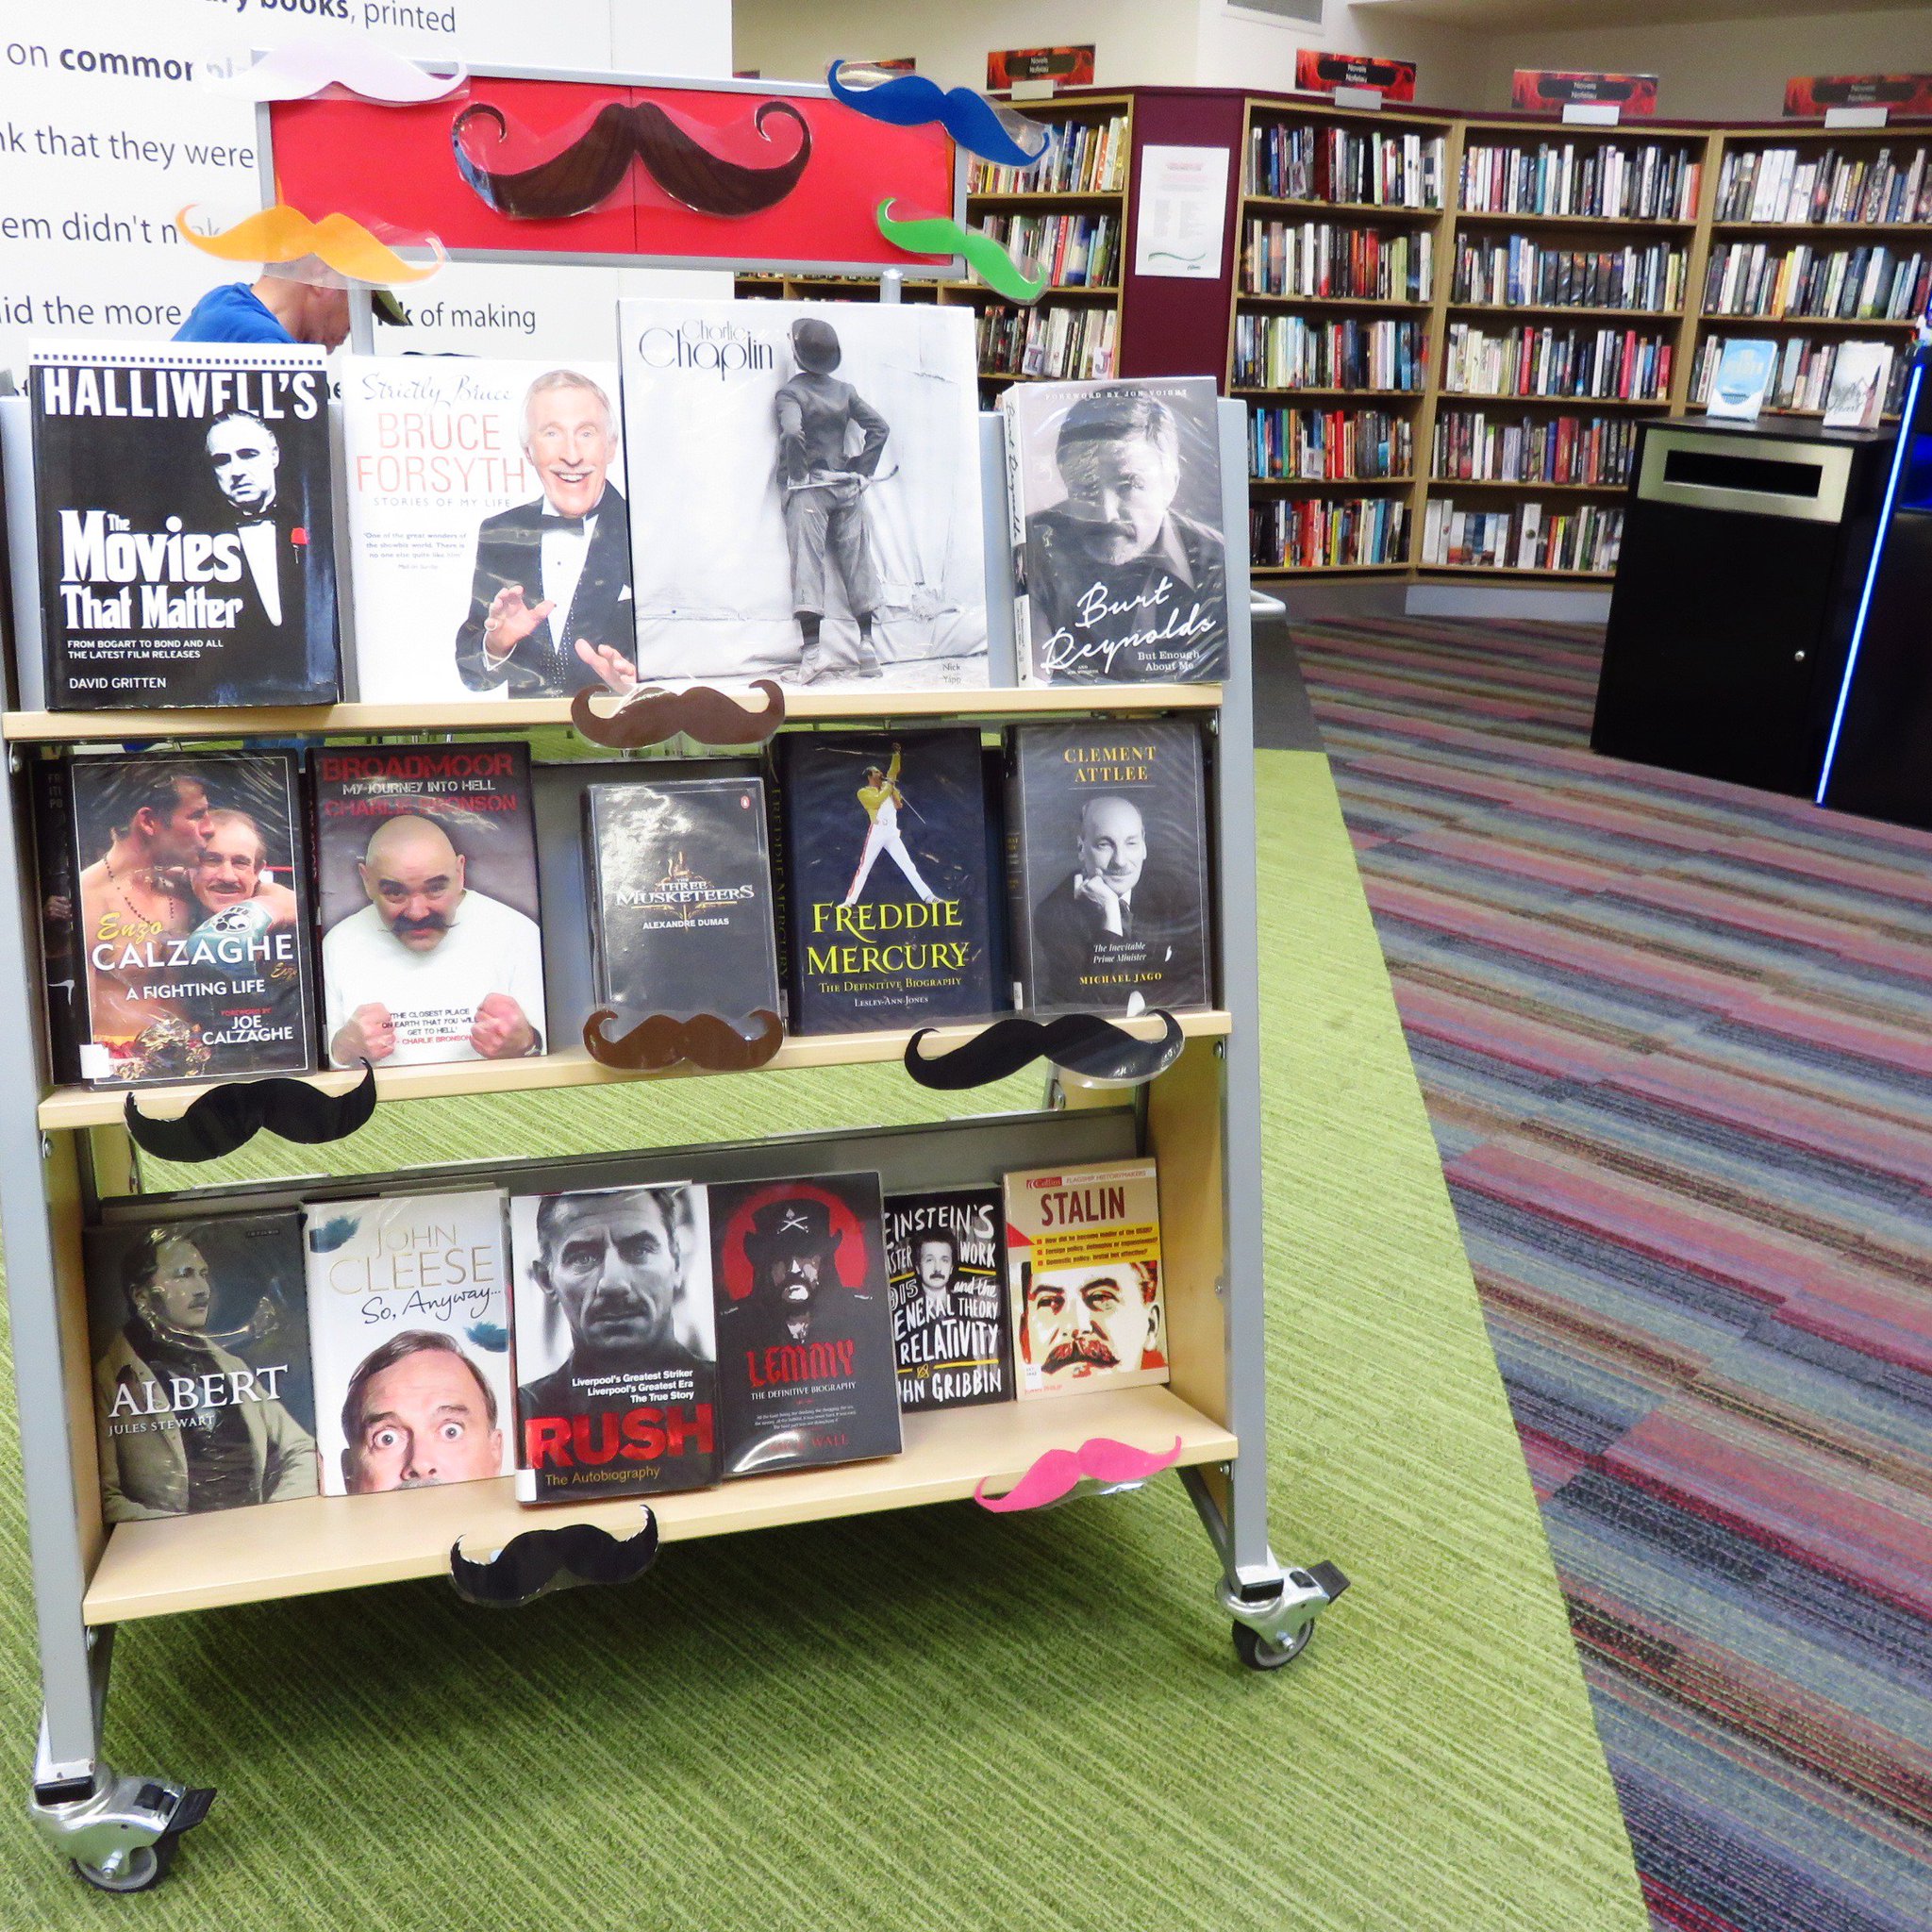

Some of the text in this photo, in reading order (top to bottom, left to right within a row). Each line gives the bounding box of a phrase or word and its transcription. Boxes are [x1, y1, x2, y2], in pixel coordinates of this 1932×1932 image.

[260, 0, 356, 24] oks,
[364, 4, 455, 33] printed
[7, 43, 48, 68] on
[1347, 63, 1367, 73] Novels
[35, 125, 254, 171] that they were
[62, 211, 152, 243] didn't
[42, 296, 181, 325] the more
[421, 302, 444, 327] of
[451, 303, 536, 335] making
[681, 319, 746, 342] Charlie
[639, 326, 774, 380] Chaplin
[1095, 352, 1112, 374] J
[43, 368, 318, 421] HALLIWELL'S
[362, 373, 451, 408] Strictly
[454, 375, 512, 402] Bruce
[378, 413, 501, 451] BRUCE
[357, 456, 525, 493] FORSYTH
[374, 497, 511, 508] STORIES OF MY LIFE
[108, 513, 130, 532] The
[58, 509, 242, 583] Movies
[60, 585, 243, 630] That Matter
[1075, 576, 1173, 628] Burt
[67, 641, 95, 649] FROM
[97, 641, 137, 649] BOGART
[154, 640, 181, 648] BOND
[183, 640, 204, 648] AND
[206, 640, 224, 648] ALL
[1041, 604, 1217, 676] Reynolds
[68, 651, 87, 659] THE
[90, 651, 125, 659] LATEST
[1137, 651, 1201, 660] But Enough
[1145, 662, 1194, 672] About Me
[69, 677, 166, 689] DAVID GRITTEN
[1064, 746, 1157, 763] CLEMENT
[322, 754, 514, 781] BROADMOOR
[1074, 767, 1149, 783] ATTLEE
[342, 780, 496, 795] MY JOURNEY INTO HELL
[617, 885, 755, 906] MUSKETEERS
[659, 881, 708, 891] THREE
[97, 912, 162, 943] Enzo
[642, 918, 729, 930] ALEXANDRE DUMAS
[812, 899, 964, 943] FREDDIE
[92, 934, 294, 971] CALZAGHE
[808, 942, 970, 975] MERCURY
[1093, 954, 1147, 963] Prime Minister
[1094, 942, 1146, 953] The Inevitable
[125, 979, 265, 1000] A FIGHTING LIFE
[1079, 973, 1162, 985] MICHAEL JAGO
[231, 1015, 262, 1029] JOE
[202, 1026, 293, 1045] CALZAGHE
[1041, 1187, 1124, 1226] STALIN
[377, 1224, 457, 1258] JOHN
[959, 1241, 995, 1268] WORK
[329, 1245, 494, 1296] CLEESE
[952, 1276, 974, 1294] and
[976, 1279, 998, 1297] the
[361, 1288, 502, 1324] So, Anyway...
[957, 1297, 999, 1320] THEORY
[900, 1318, 1000, 1365] RELATIVITY
[746, 1340, 855, 1388] LEMMY
[572, 1370, 693, 1387] Liverpool's Greatest Striker
[588, 1380, 694, 1396] Liverpool's Greatest Era
[751, 1381, 857, 1400] THE DEFINITIVE BIOGRAPHY
[932, 1368, 1002, 1402] GRIBBIN
[108, 1364, 289, 1418] ALBERT
[630, 1391, 694, 1403] The True Story
[108, 1415, 215, 1437] JULES STEWART
[525, 1404, 714, 1469] RUSH
[545, 1466, 661, 1486] The Autobiography
